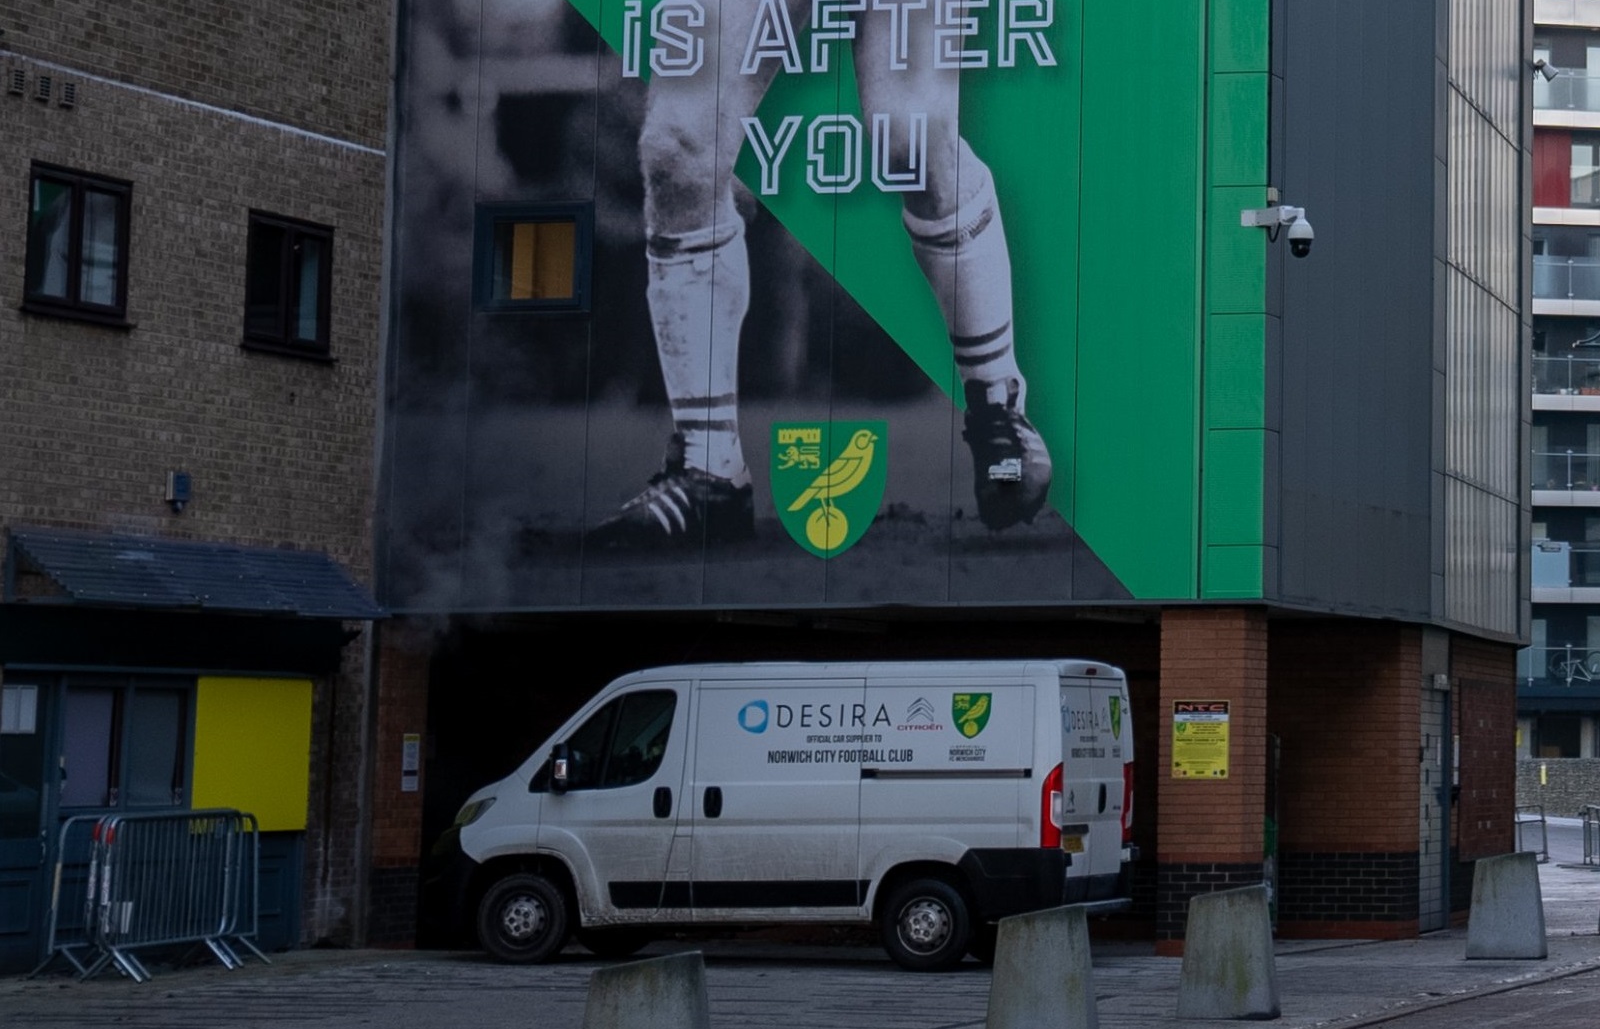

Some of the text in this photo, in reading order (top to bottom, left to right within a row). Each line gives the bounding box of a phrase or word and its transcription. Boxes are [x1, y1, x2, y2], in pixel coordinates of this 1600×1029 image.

[739, 111, 928, 197] YOU
[776, 703, 891, 728] DESIRA
[806, 734, 882, 743] OFFICIAL CAR SUPPLIER TO
[767, 748, 914, 764] NORWICH CITY FOOTBALL CLUB
